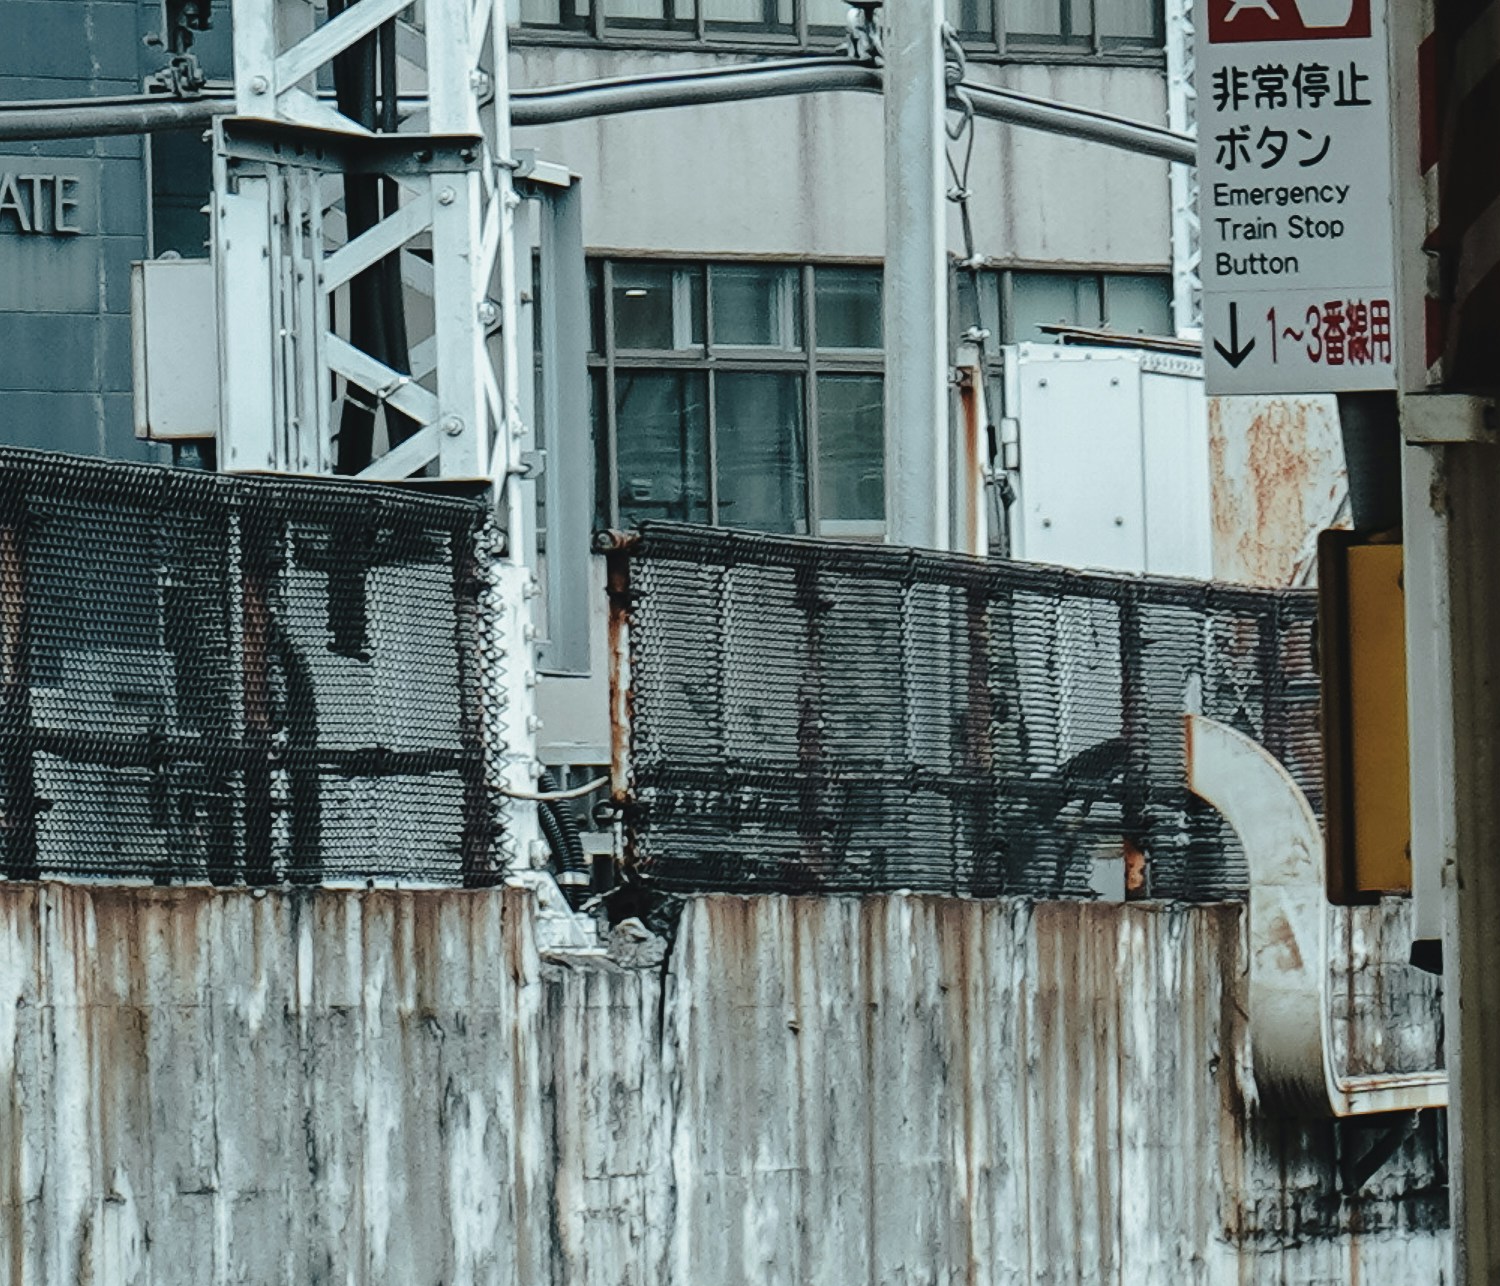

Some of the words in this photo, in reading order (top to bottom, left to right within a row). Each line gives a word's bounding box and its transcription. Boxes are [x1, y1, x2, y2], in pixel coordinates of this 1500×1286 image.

[1212, 61, 1372, 112] 非常停止
[1215, 124, 1331, 171] ボタン
[1213, 183, 1350, 207] Emergency
[1215, 216, 1277, 241] Train
[1288, 214, 1345, 240] Stop
[1215, 251, 1300, 276] Button
